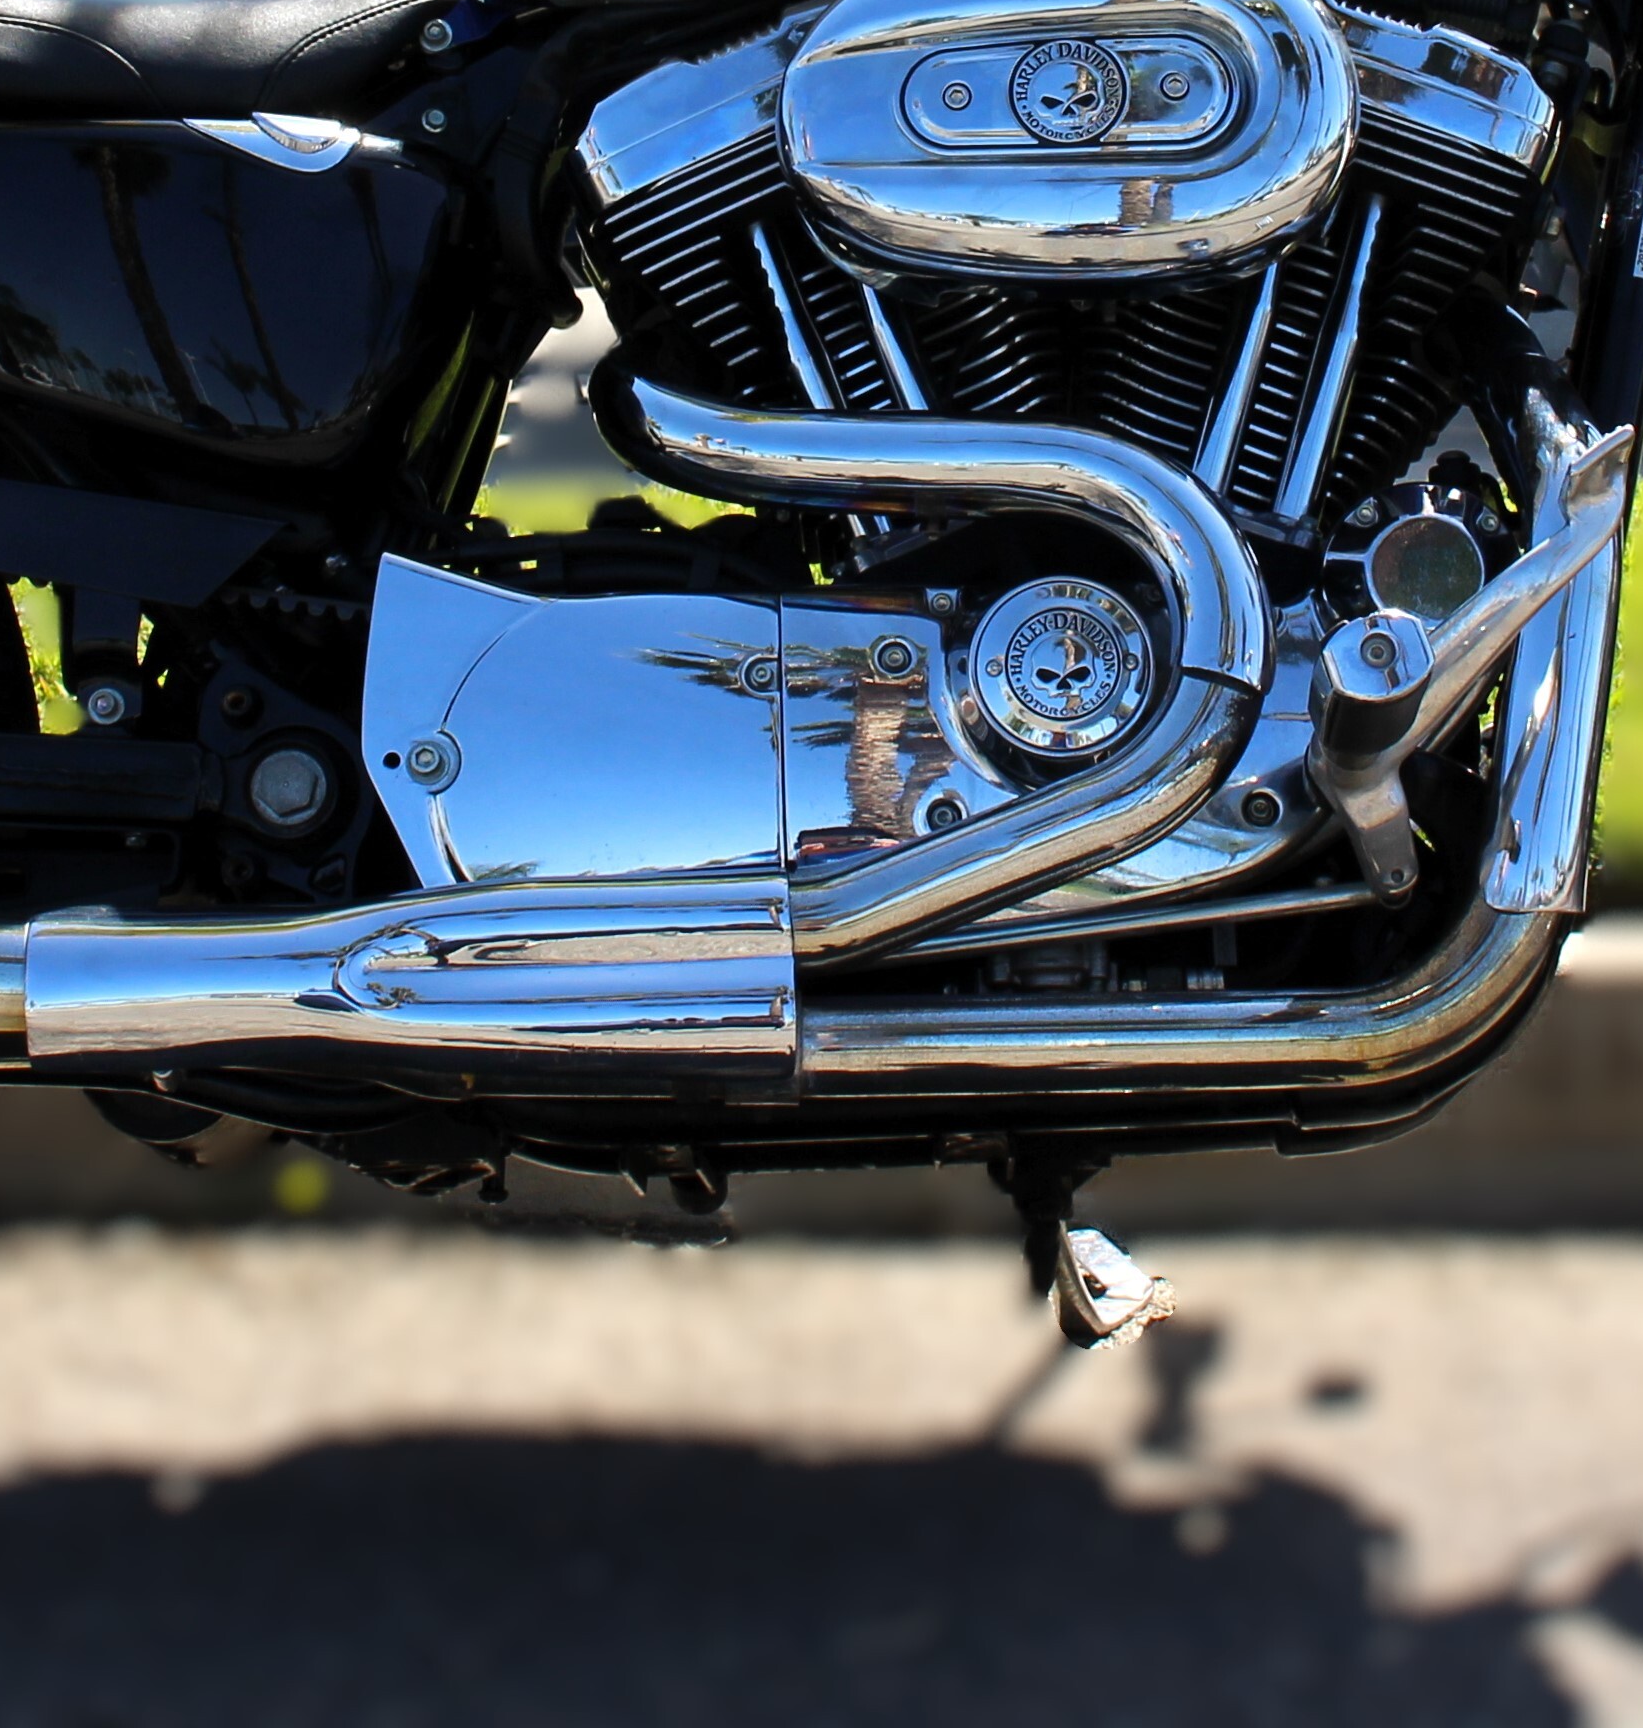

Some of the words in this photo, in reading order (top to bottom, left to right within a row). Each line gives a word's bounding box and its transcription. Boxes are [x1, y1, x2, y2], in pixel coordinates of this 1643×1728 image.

[1016, 44, 1054, 101] HARLEY
[1058, 42, 1119, 101] DAVIDSON
[1021, 103, 1116, 140] MOTORCYCLES
[1015, 680, 1111, 716] MOTORCYCLES
